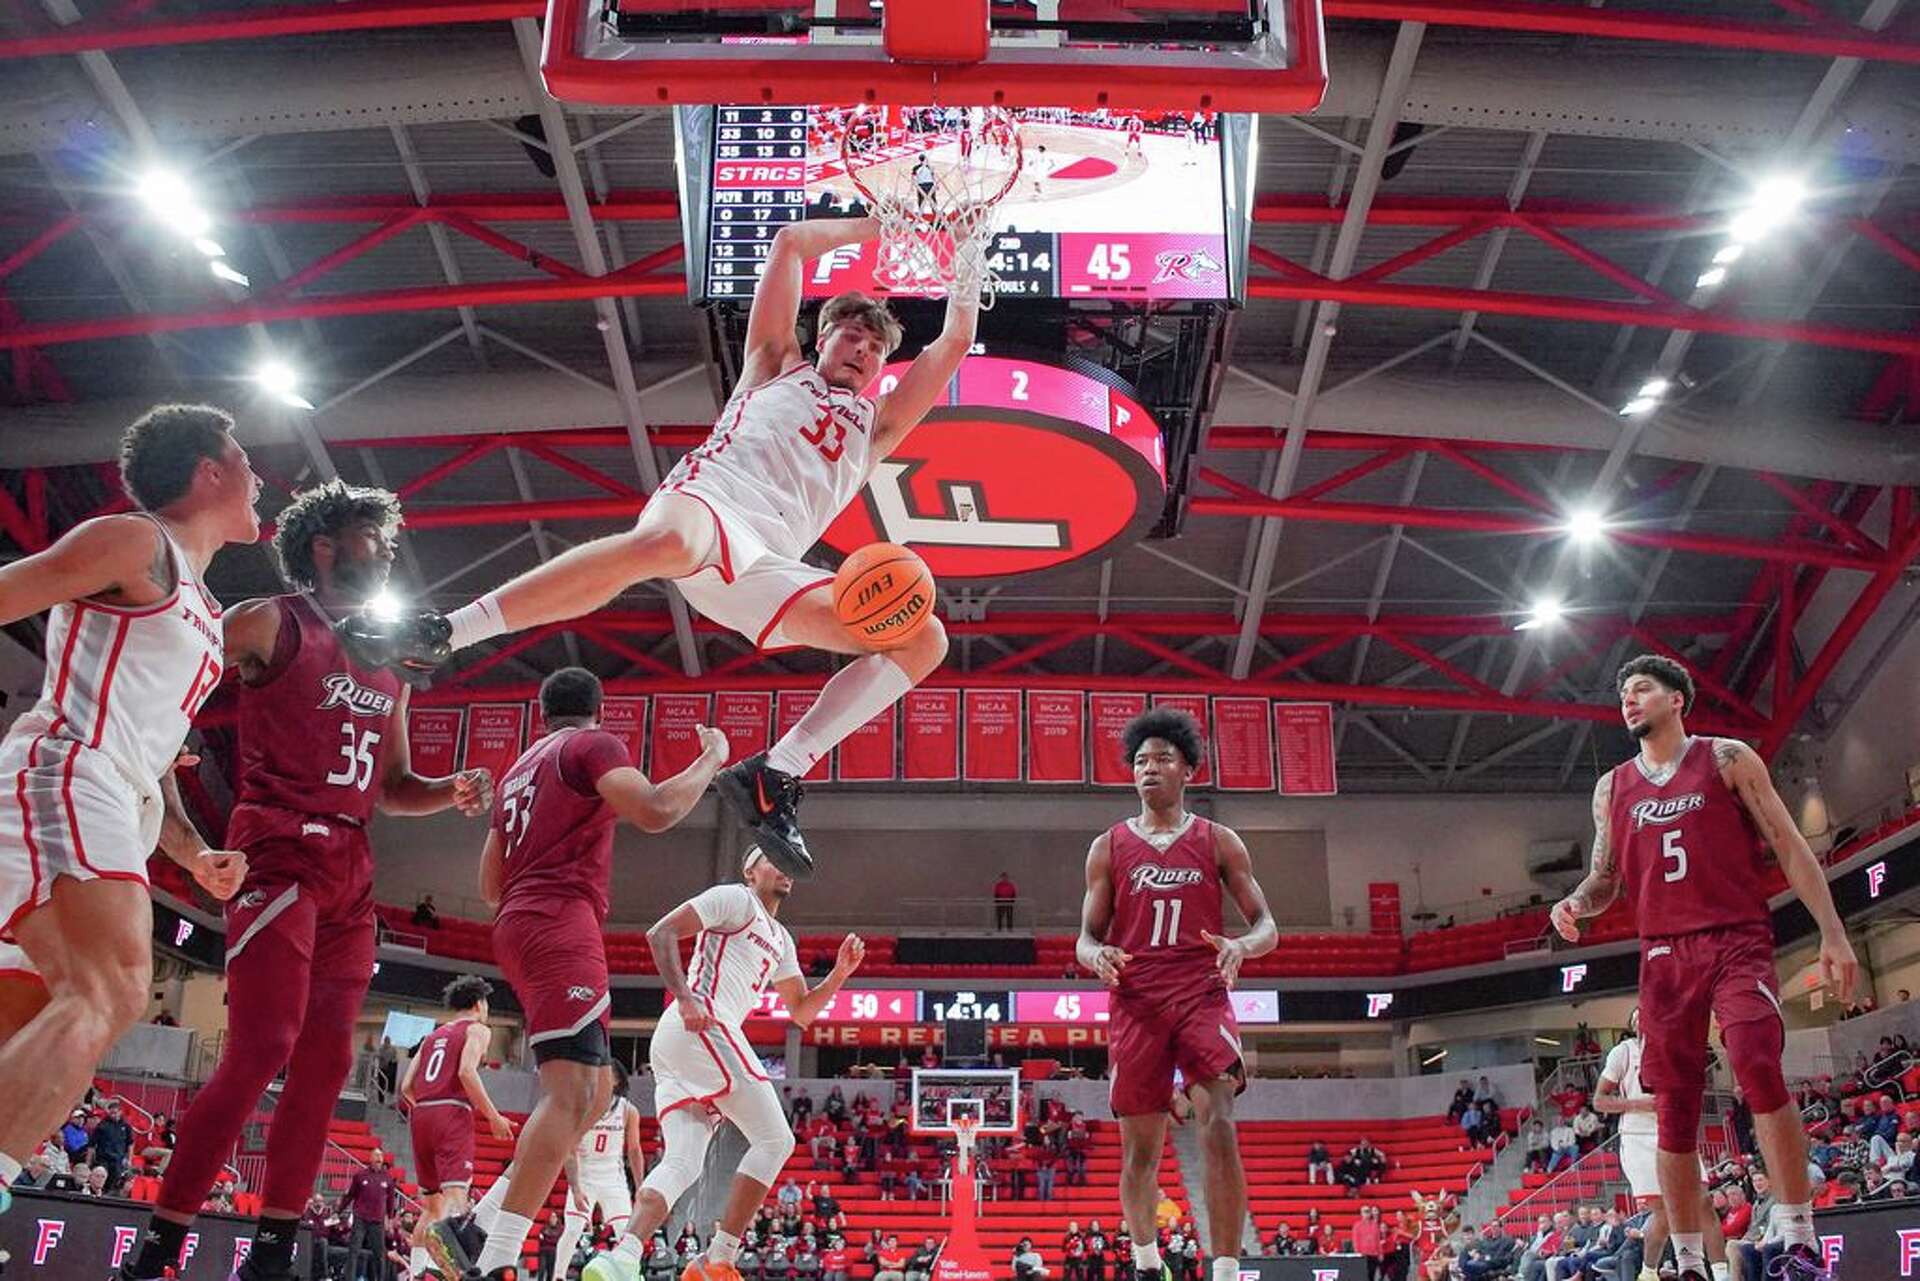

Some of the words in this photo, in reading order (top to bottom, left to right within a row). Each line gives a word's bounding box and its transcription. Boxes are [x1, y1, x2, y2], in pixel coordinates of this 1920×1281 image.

[725, 111, 739, 122] 11
[761, 111, 772, 122] 2
[791, 111, 803, 122] 0
[756, 128, 775, 139] 10
[790, 128, 803, 139] 0
[789, 146, 801, 157] 0
[719, 167, 802, 181] STAGS
[753, 191, 774, 203] PTS
[720, 210, 733, 220] 0
[753, 209, 771, 220] 17
[789, 209, 797, 220] 1
[716, 245, 734, 256] 12
[987, 252, 1051, 271] 4:14
[1087, 243, 1131, 280] 45
[1030, 280, 1039, 293] 4
[1011, 370, 1029, 401] 2
[799, 404, 847, 462] 33
[863, 593, 925, 635] Wilson
[666, 708, 696, 716] NCAA
[728, 704, 758, 714] NCAA
[916, 703, 945, 711] NCAA
[978, 703, 1007, 711] NCAA
[1040, 704, 1070, 712] NCAA
[1103, 707, 1132, 715] NCAA
[480, 718, 510, 726] NCAA
[326, 722, 382, 792] 35
[1662, 829, 1688, 883] 5
[1866, 861, 1886, 898] F
[1150, 899, 1183, 946] 11
[1561, 964, 1587, 992] F
[852, 994, 878, 1019] 50
[933, 1002, 1001, 1021] 14:14
[1053, 995, 1081, 1020] 45
[1366, 993, 1393, 1017] F
[814, 1026, 861, 1046] HE
[425, 1049, 446, 1082] 0
[594, 1134, 607, 1152] 0
[33, 1219, 65, 1265] F
[111, 1226, 138, 1268] F
[178, 1232, 200, 1271] F
[1895, 1228, 1920, 1276] F
[1818, 1234, 1843, 1278] F
